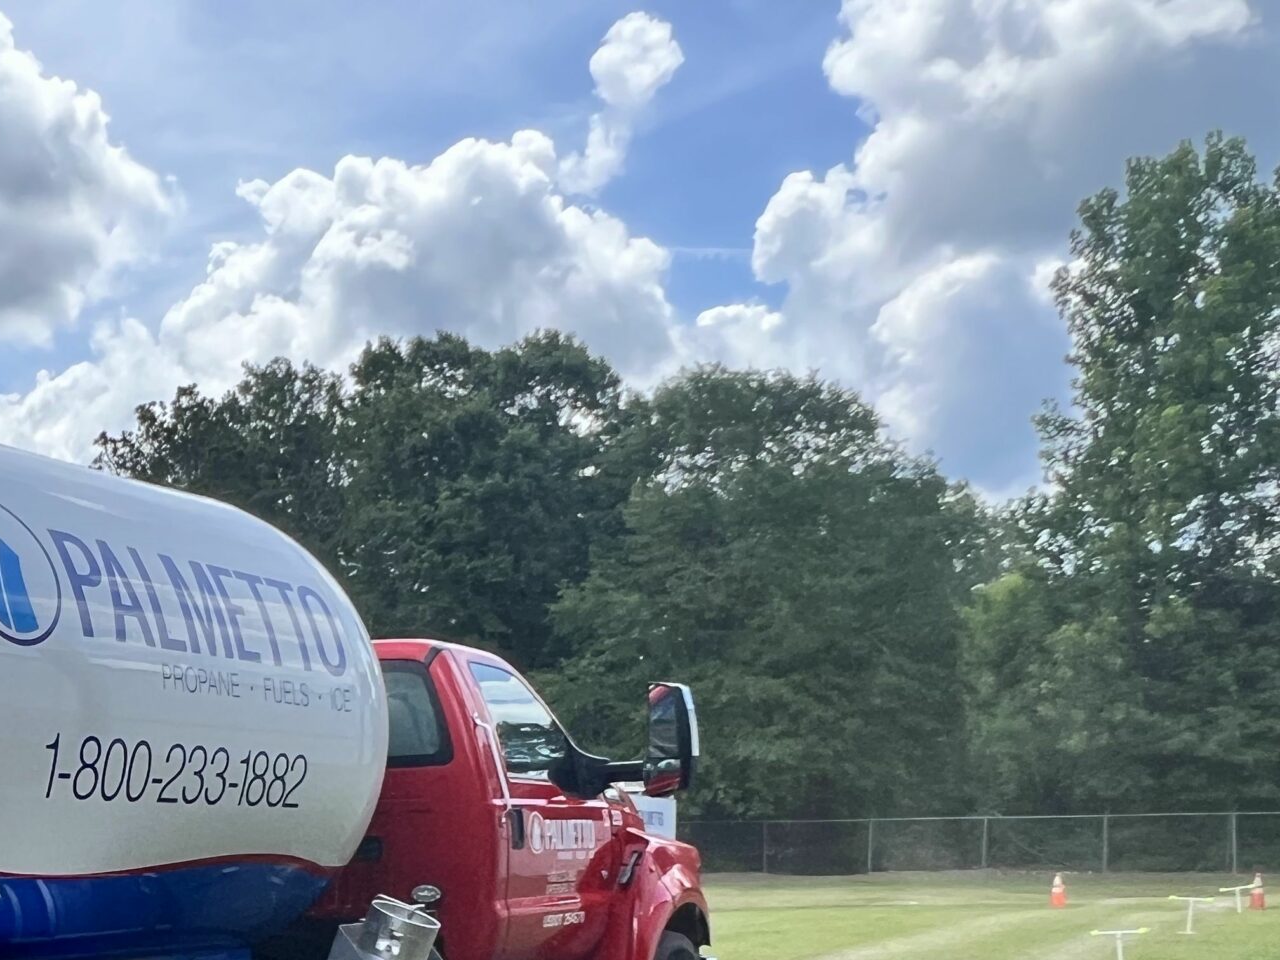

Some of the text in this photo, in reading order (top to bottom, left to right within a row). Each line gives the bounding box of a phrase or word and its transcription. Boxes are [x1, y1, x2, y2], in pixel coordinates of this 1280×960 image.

[46, 528, 347, 677] PALMETTO
[161, 663, 353, 713] PROPANE FUELS ICE
[44, 733, 308, 808] 1-800-233-1882
